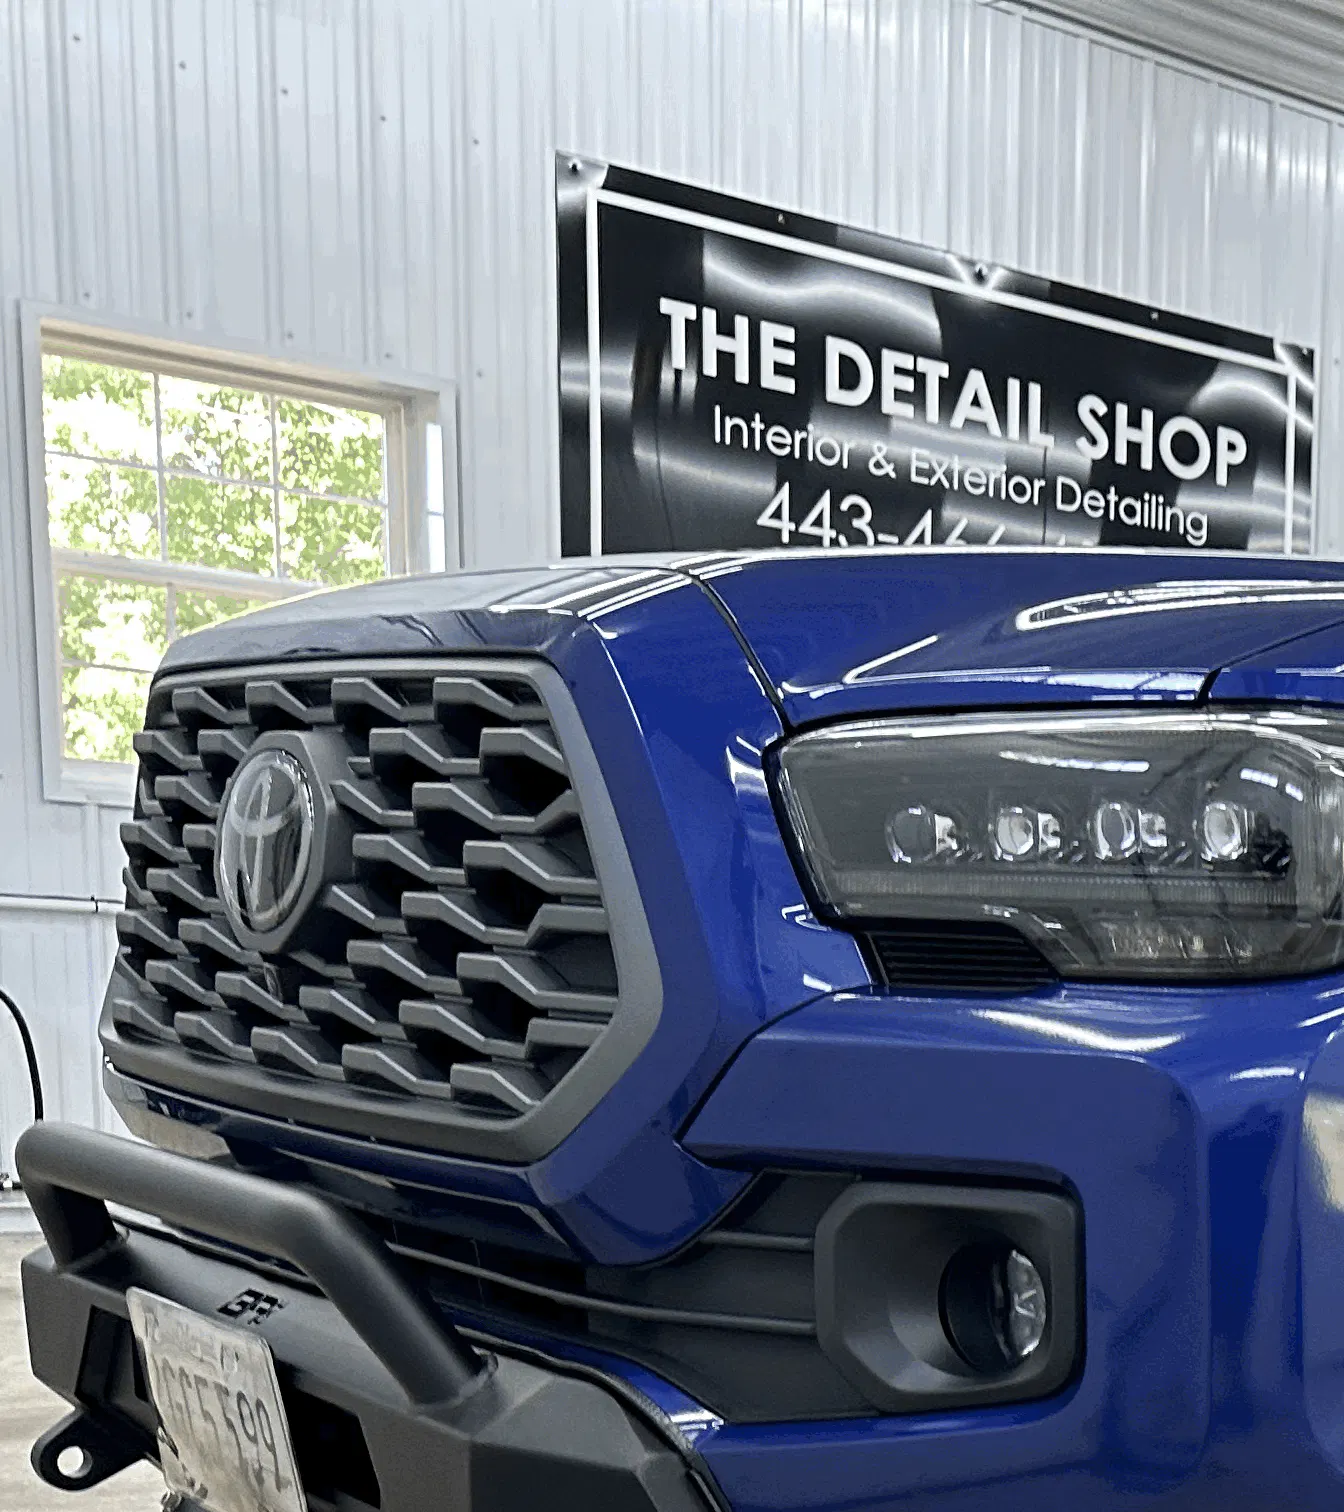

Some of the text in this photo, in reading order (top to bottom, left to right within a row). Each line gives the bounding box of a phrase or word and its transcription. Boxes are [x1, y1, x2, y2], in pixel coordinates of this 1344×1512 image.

[659, 296, 1248, 488] THE DETAIL SHOP
[714, 404, 1209, 547] Interior & Exterior Detailing
